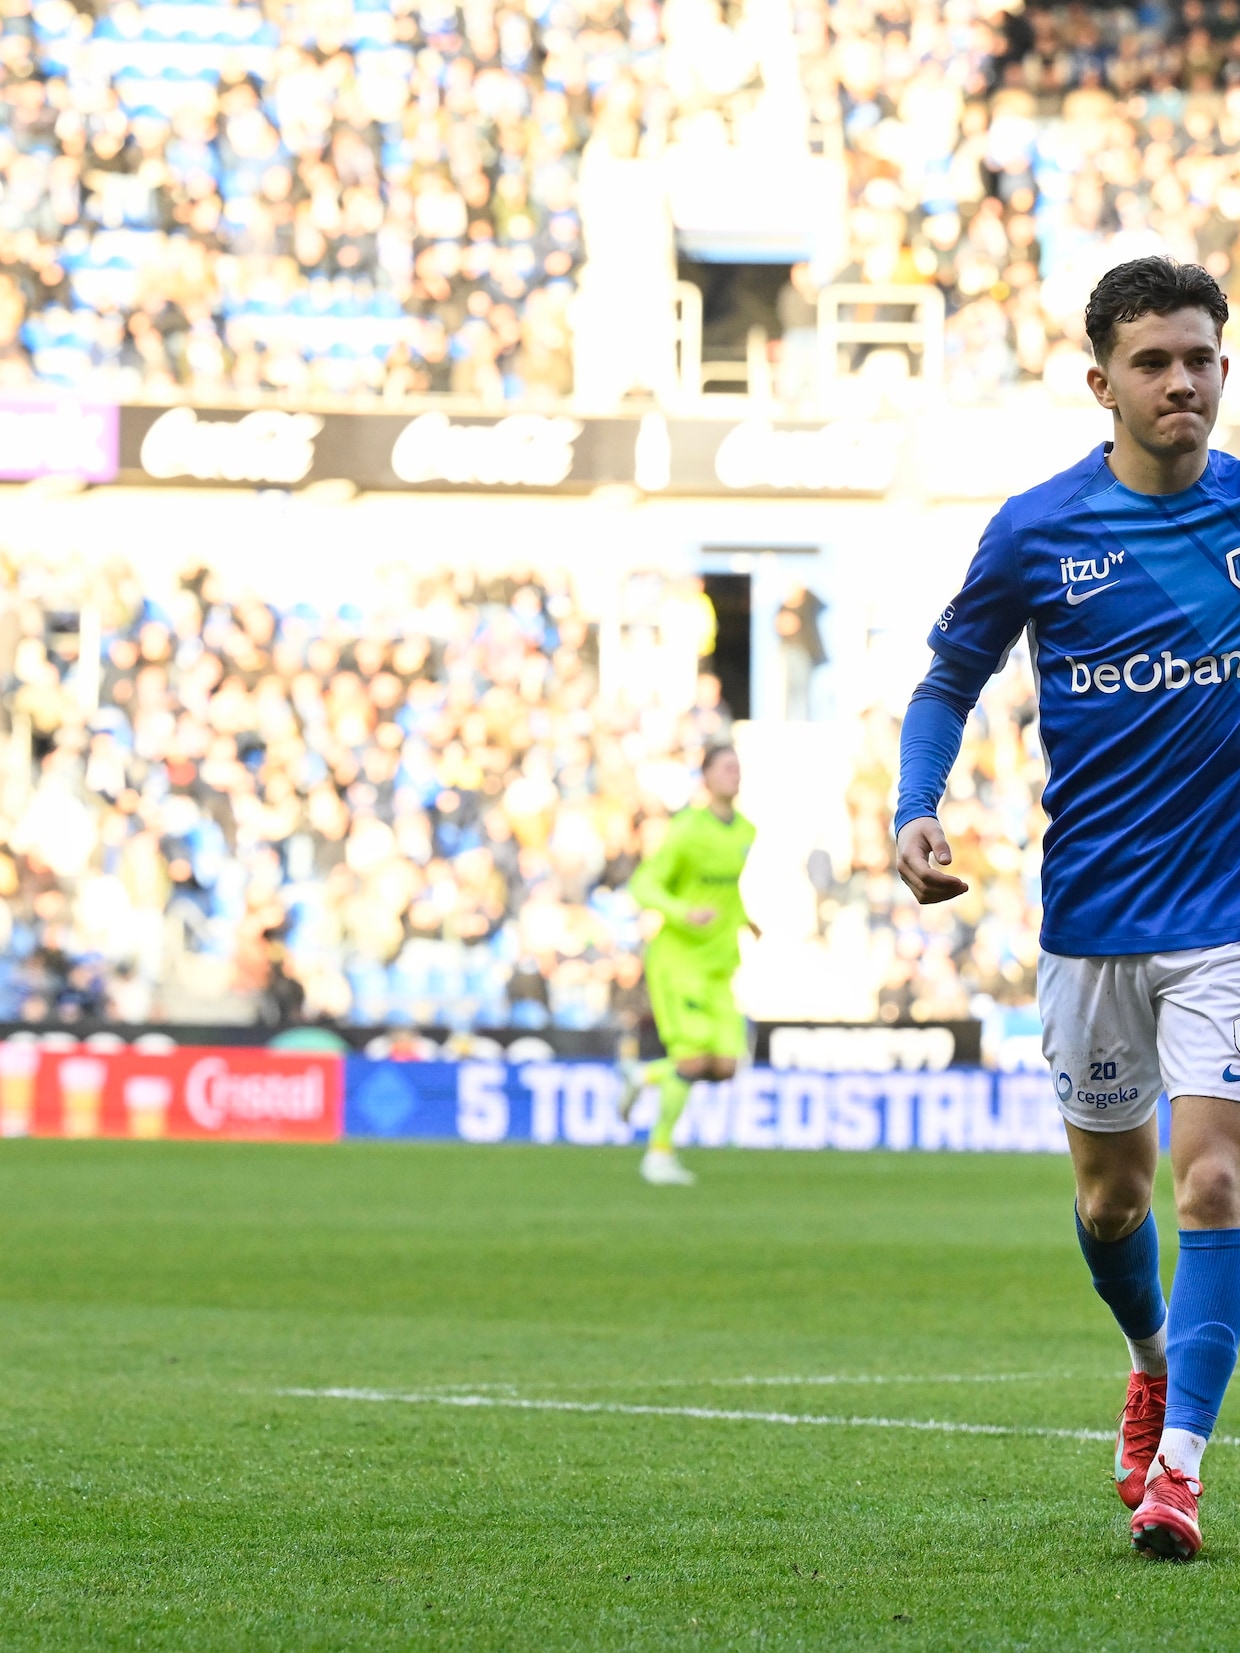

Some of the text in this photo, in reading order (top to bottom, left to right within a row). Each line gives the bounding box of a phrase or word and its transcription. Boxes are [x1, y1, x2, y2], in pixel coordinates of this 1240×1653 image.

[1060, 556, 1110, 584] itzu
[1090, 1061, 1117, 1080] 20
[456, 1062, 510, 1144] 5
[1077, 1086, 1138, 1110] cegeka
